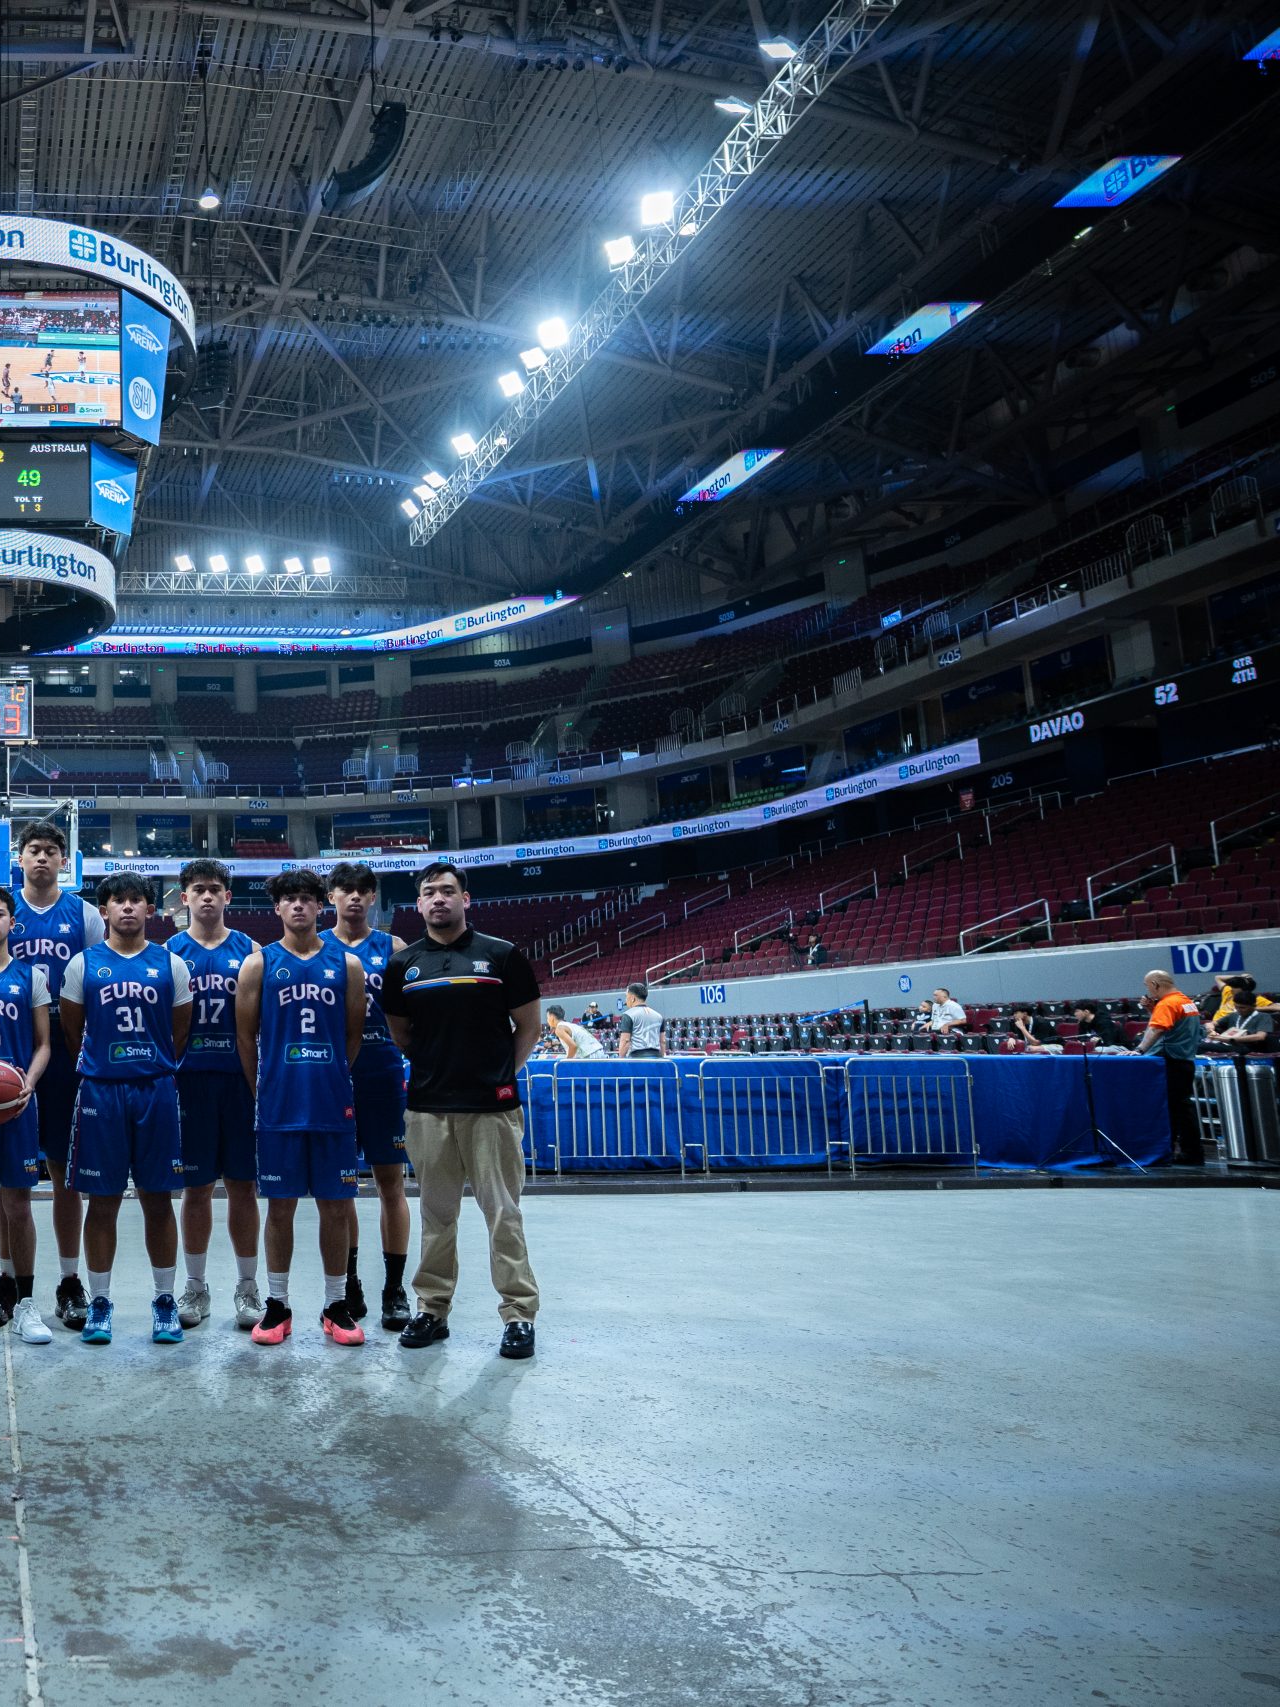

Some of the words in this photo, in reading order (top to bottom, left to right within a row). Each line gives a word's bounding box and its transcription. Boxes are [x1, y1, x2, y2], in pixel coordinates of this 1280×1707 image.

[100, 245, 189, 324] Burlington
[129, 333, 161, 354] ARENA
[132, 381, 153, 416] SM
[30, 443, 87, 453] AUSTRALIA
[17, 470, 41, 487] 49
[99, 488, 125, 505] ARENA
[467, 603, 525, 628] Burlington
[387, 629, 443, 649] Burlington
[104, 641, 165, 655] Burlington
[939, 649, 961, 666] 405
[1232, 656, 1253, 669] QTR
[1231, 666, 1257, 683] 4TH
[69, 686, 82, 694] 501
[1154, 682, 1179, 706] 52
[773, 720, 789, 732] 404
[1029, 711, 1084, 743] DAVAO
[908, 752, 960, 777] Burlington
[834, 776, 877, 798] Burlington
[991, 772, 1014, 788] 205
[78, 801, 95, 809] 401
[250, 801, 268, 809] 402
[770, 798, 808, 816] Burlington
[682, 819, 730, 835] Burlington
[608, 833, 651, 850] Burlington
[448, 852, 494, 864] Burlington
[526, 843, 574, 858] Burlington
[114, 862, 160, 873] Burlington
[369, 858, 416, 868] Burlington
[523, 866, 542, 876] 203
[12, 938, 71, 961] EURO
[1178, 941, 1236, 973] 107
[190, 974, 237, 995] EURO
[100, 981, 158, 1006] EURO
[278, 984, 336, 1006] EURO
[702, 986, 724, 1003] 106
[116, 1006, 145, 1032] 31
[198, 998, 225, 1024] 17
[300, 1007, 315, 1034] 2
[204, 1037, 231, 1048] Smart
[301, 1047, 328, 1059] Smart
[24, 1158, 36, 1166] PLAY
[24, 1165, 37, 1173] TIME
[340, 1169, 356, 1177] PLAY
